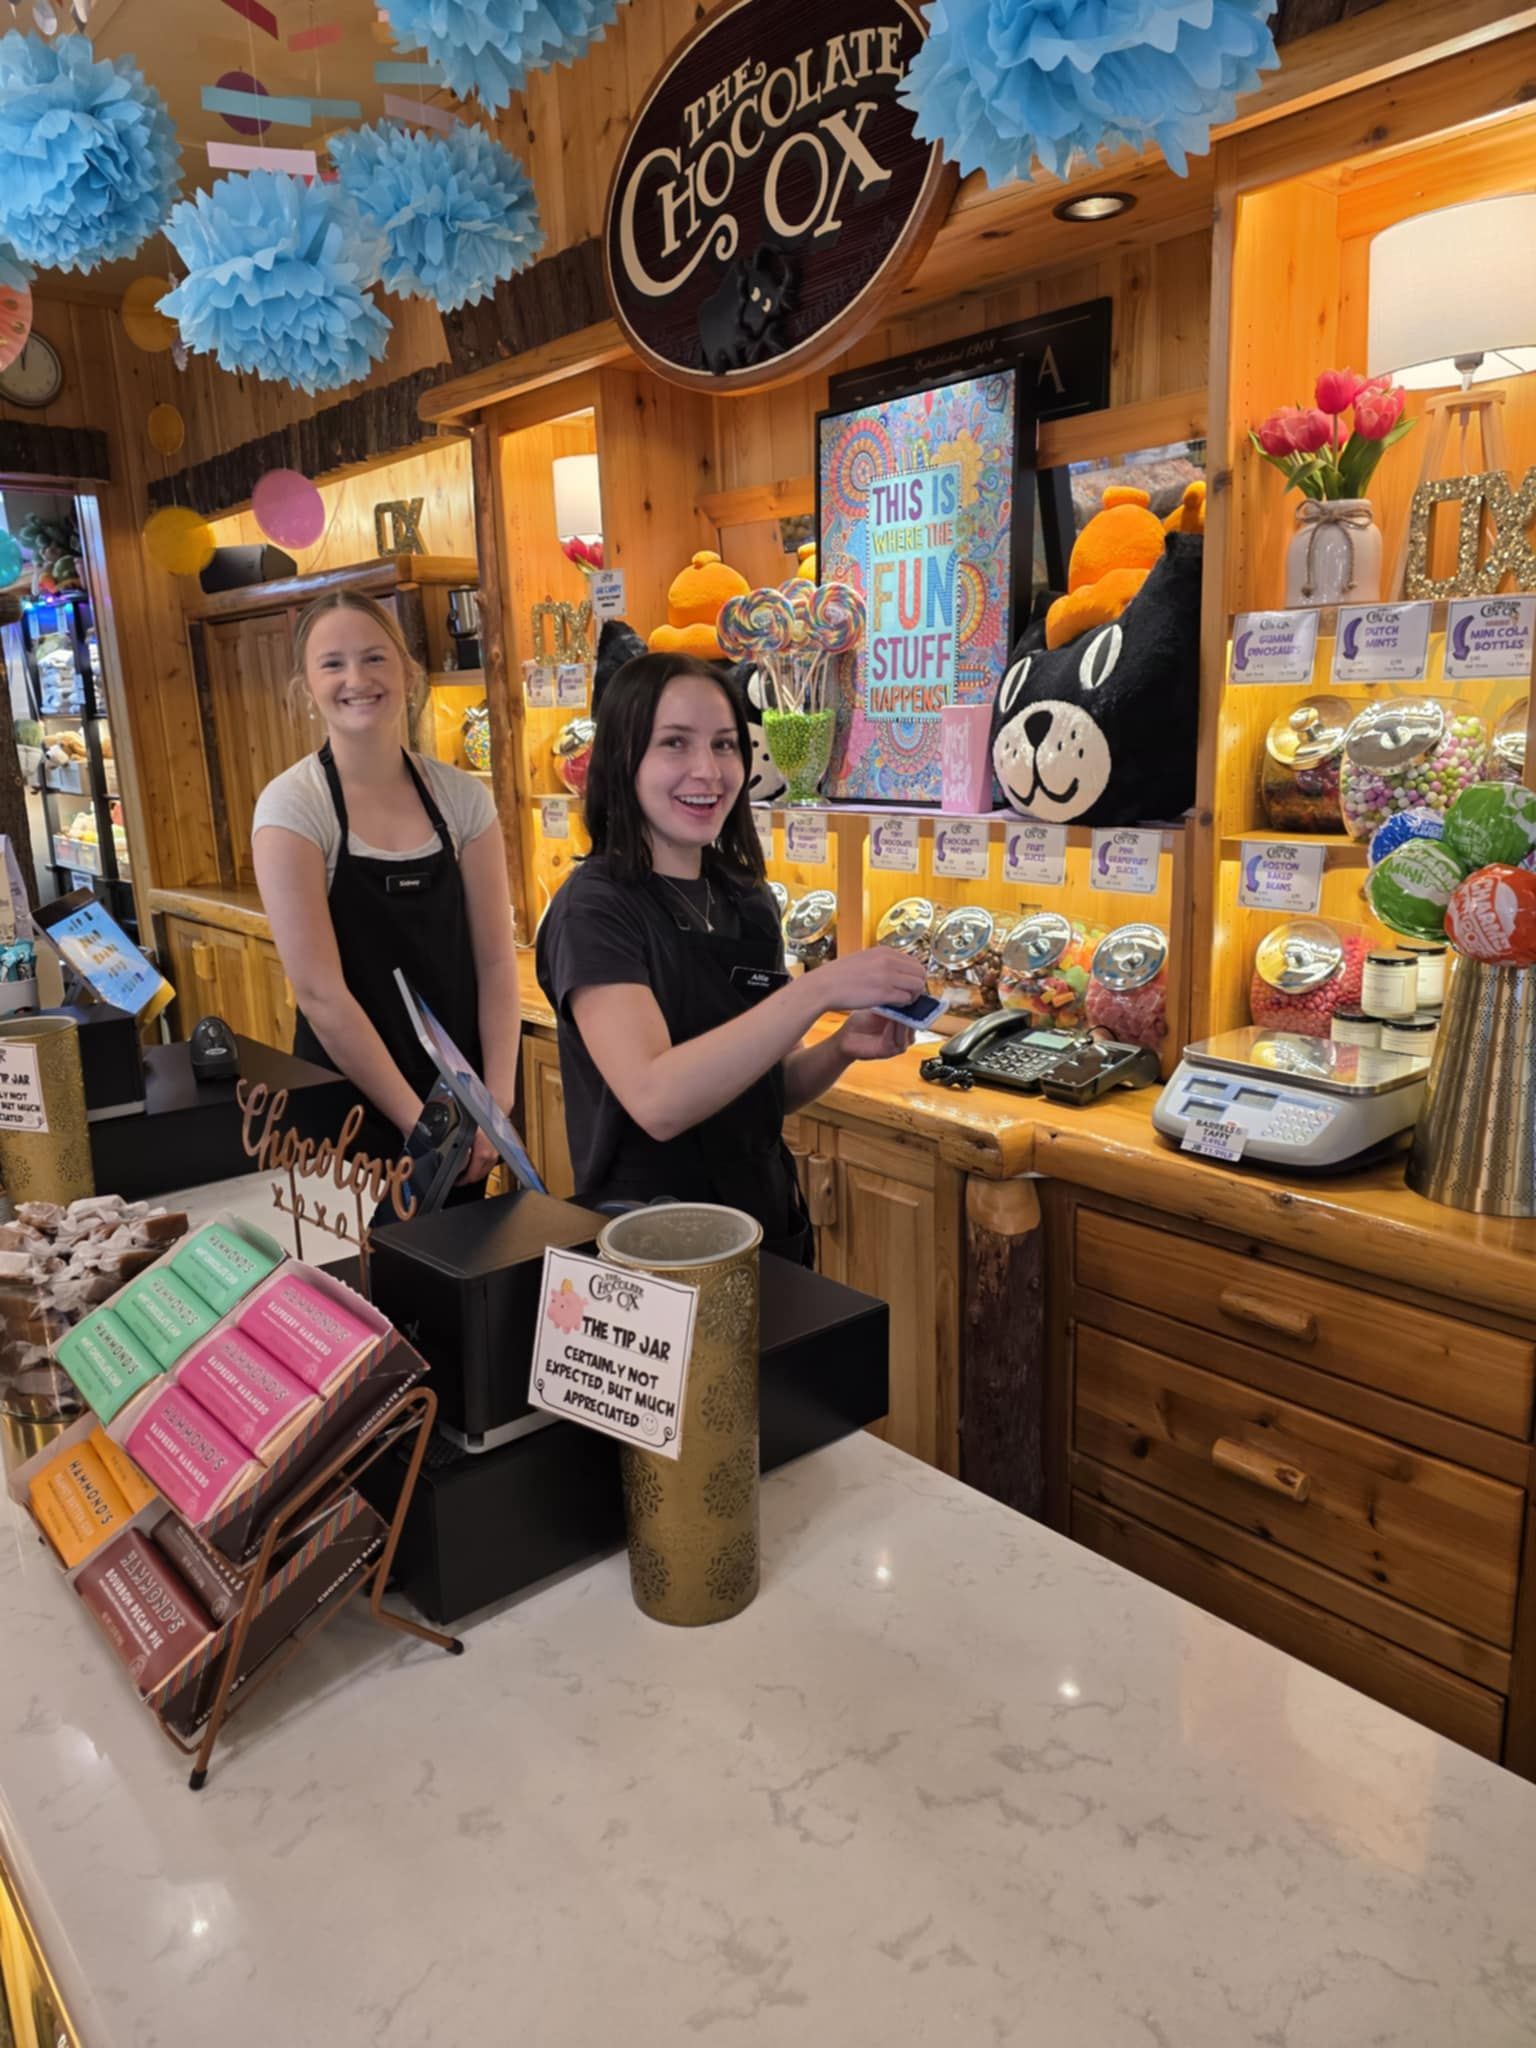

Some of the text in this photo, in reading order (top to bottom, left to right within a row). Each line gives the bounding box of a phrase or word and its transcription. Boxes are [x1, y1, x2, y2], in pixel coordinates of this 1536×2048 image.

[684, 57, 766, 148] THE
[620, 22, 904, 297] CHOCOLATE
[764, 102, 892, 238] OX
[873, 473, 955, 525] THIS IS
[873, 520, 953, 555] WHERE THE
[873, 555, 954, 632] FUN
[1365, 626, 1399, 636] DUTCH
[1365, 638, 1398, 648] MINTS
[1471, 626, 1528, 638] MINI COLA
[1475, 640, 1524, 651] BOTTLES
[872, 633, 952, 681] STUFF
[871, 684, 950, 713] HAPPENS!
[1263, 861, 1300, 870] BOSTON
[1471, 878, 1512, 952] CHARMS
[10, 1092, 27, 1100] NOT
[11, 1073, 30, 1086] JAR
[1203, 1129, 1231, 1140] TAFFY
[207, 1233, 256, 1275] HAMMOND'S
[150, 1279, 199, 1327] HAMMOND'S
[589, 1274, 644, 1302] CHOCOLATE
[617, 1291, 639, 1311] OX
[267, 1300, 332, 1357] RASPBERRY HABANERO
[281, 1286, 352, 1345] HAMMOND'S
[582, 1316, 671, 1360] THE TIP JAR
[93, 1321, 140, 1376] HAMMOND'S
[222, 1340, 290, 1403] HAMMOND'S
[564, 1345, 659, 1389] CERTAINLY NOT
[207, 1355, 270, 1416] RASPBERRY HABANERO
[546, 1359, 675, 1417] EXPECTED, BUT MUCH
[563, 1389, 640, 1427] APPRECIATED
[163, 1405, 229, 1472] HAMMOND'S
[354, 1392, 401, 1438] CHOCOLATE
[149, 1422, 182, 1457] RASPBERRY
[177, 1452, 211, 1489] HABANERO
[70, 1460, 115, 1526] HAMMOND'S
[119, 1549, 187, 1636] HAMMOND'S
[316, 1556, 364, 1604] CHOCOLATE
[104, 1568, 135, 1608] BOURBON
[129, 1604, 153, 1635] PECAN
[147, 1630, 164, 1649] PIE
